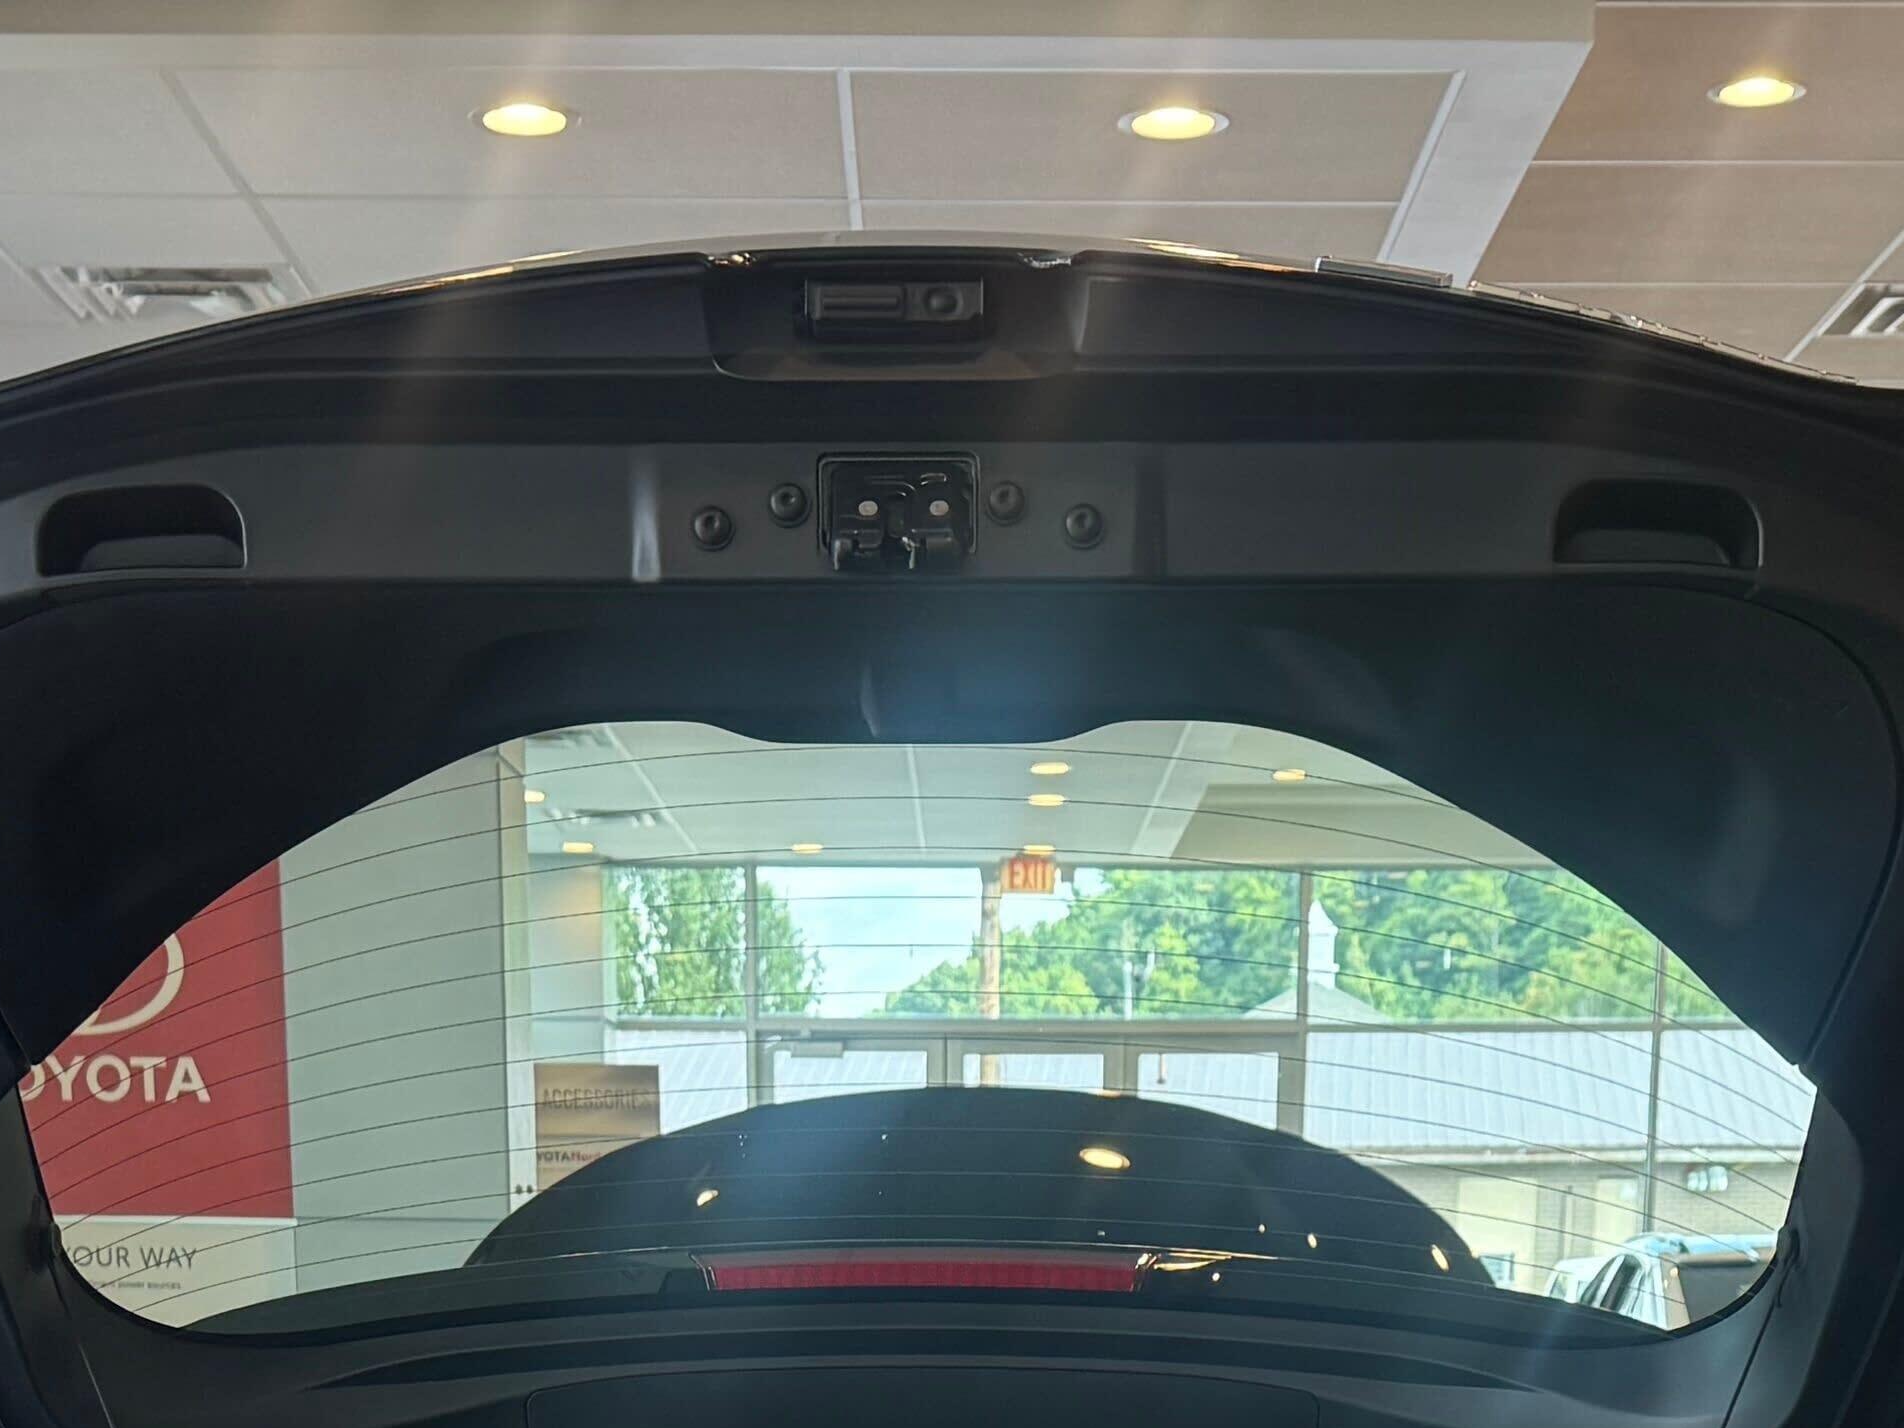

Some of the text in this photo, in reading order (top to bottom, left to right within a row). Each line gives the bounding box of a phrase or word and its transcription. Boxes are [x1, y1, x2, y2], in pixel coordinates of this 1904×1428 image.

[1008, 859, 1049, 889] EXIT
[64, 1245, 199, 1270] OUR WAY
